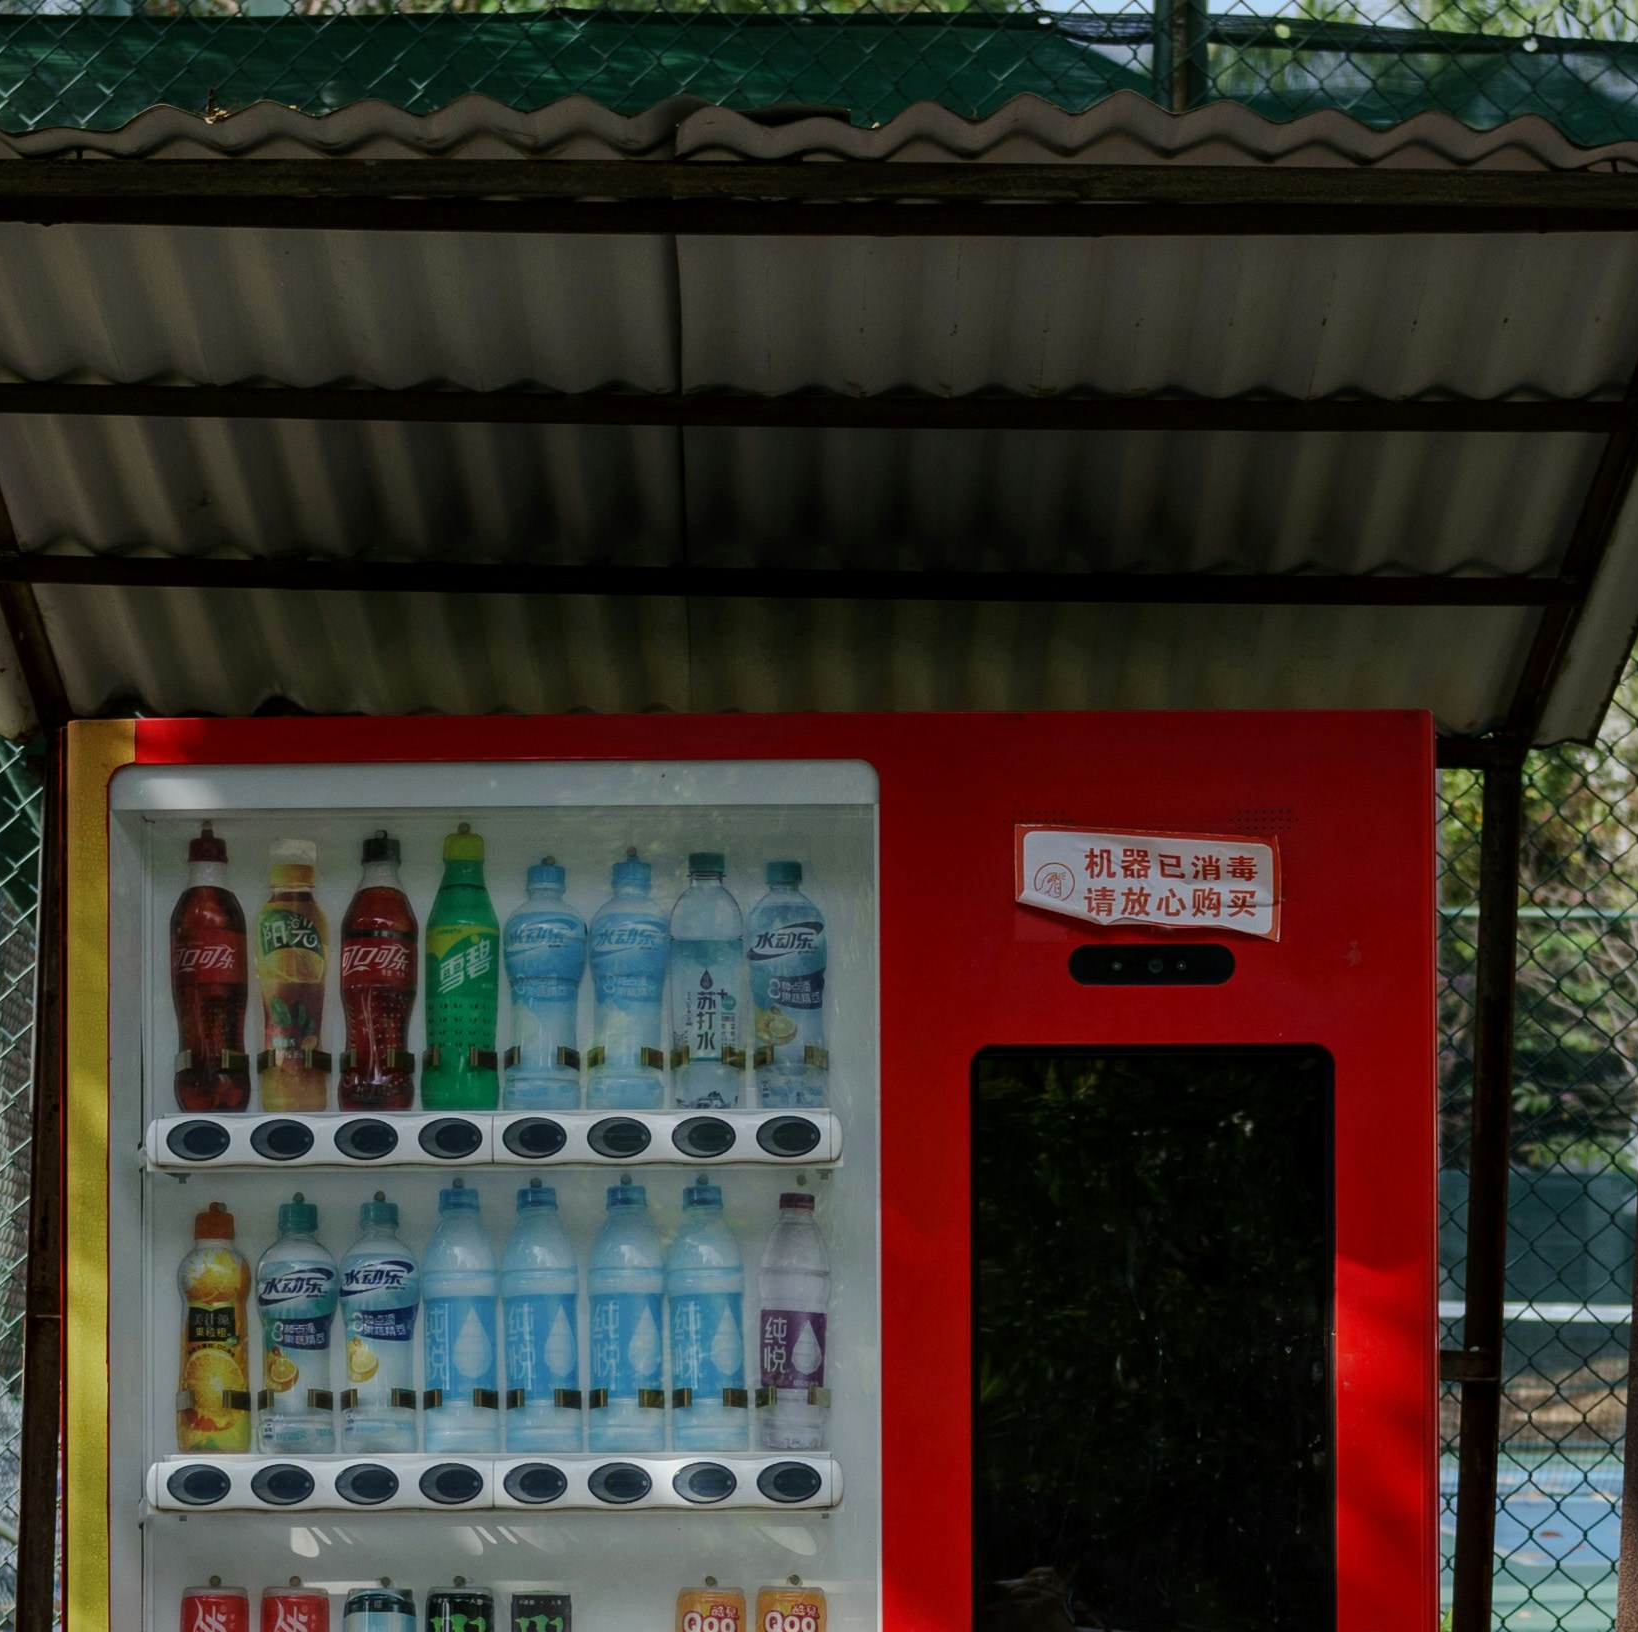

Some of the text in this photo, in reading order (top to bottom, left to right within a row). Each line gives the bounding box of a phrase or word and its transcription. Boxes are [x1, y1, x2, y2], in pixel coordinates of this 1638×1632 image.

[1084, 848, 1258, 882] 机器已消毒
[1083, 887, 1257, 919] 请放心购买
[262, 915, 318, 950] 阳光
[754, 931, 815, 950] 水动乐
[342, 943, 411, 976] 可口可乐
[437, 938, 494, 995] 雪碧
[696, 991, 717, 1051] 苏打水
[262, 1276, 326, 1295] 水动乐
[344, 1269, 406, 1286] 水动乐
[763, 1316, 788, 1374] 纯悦
